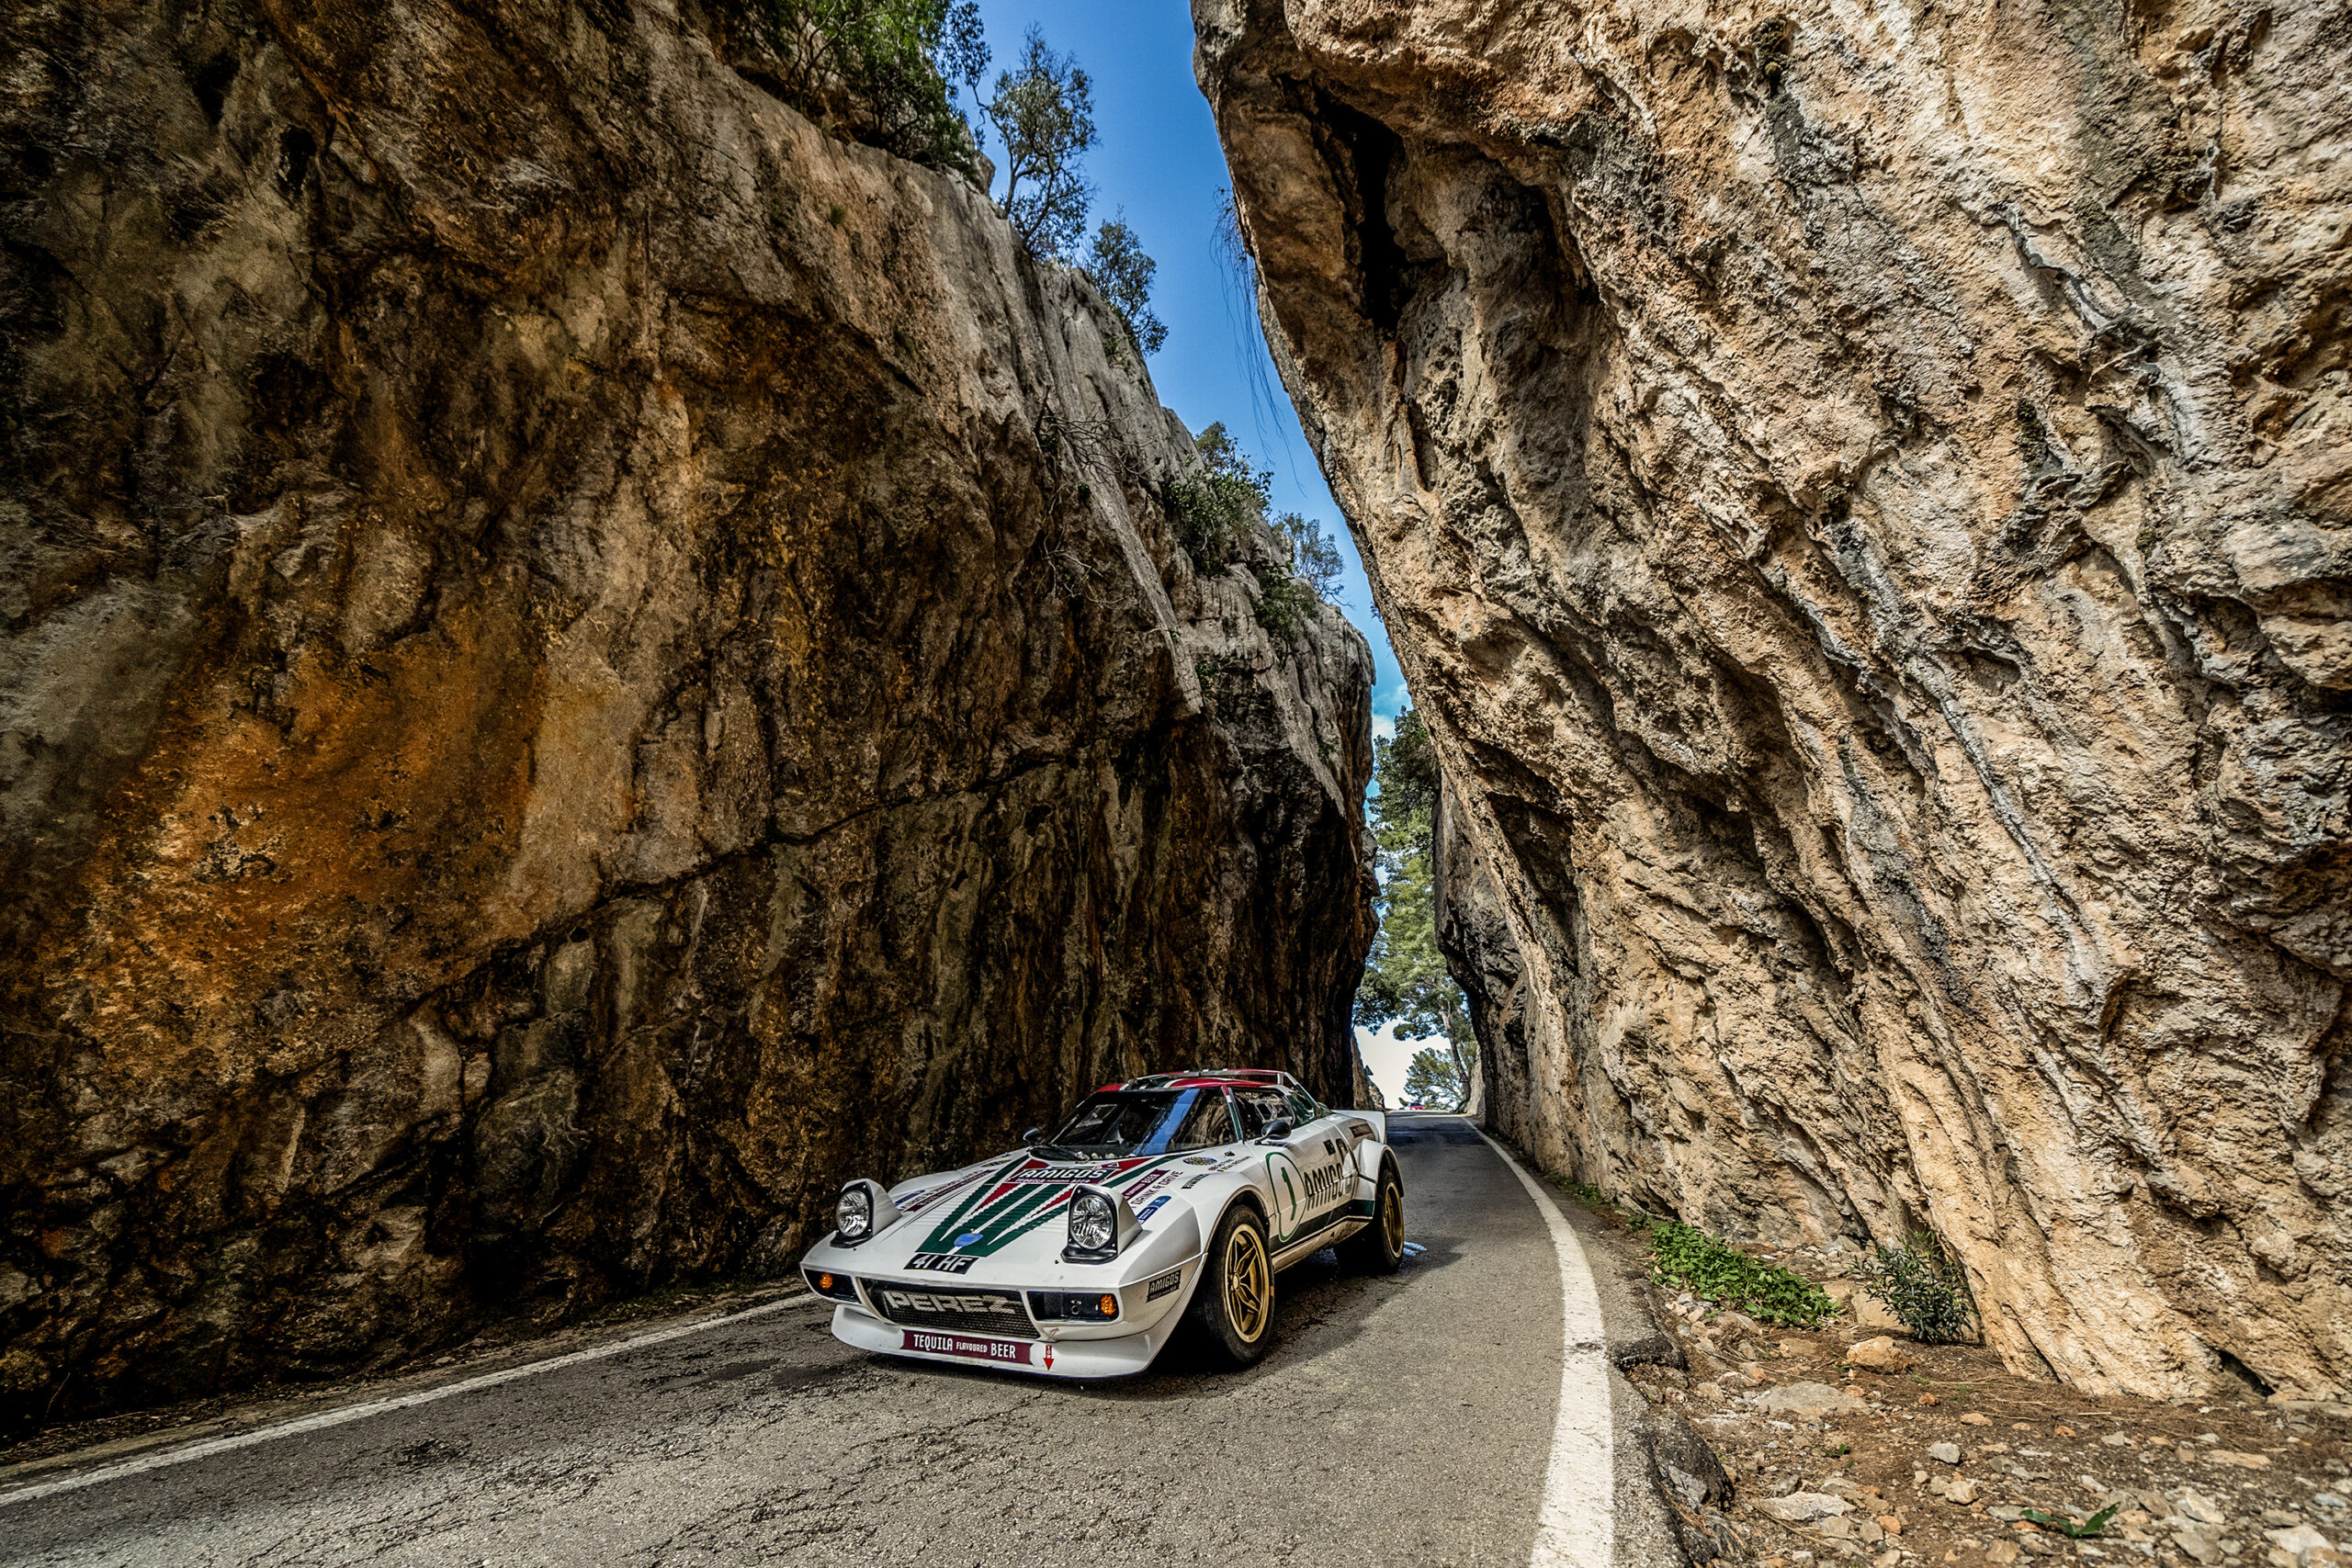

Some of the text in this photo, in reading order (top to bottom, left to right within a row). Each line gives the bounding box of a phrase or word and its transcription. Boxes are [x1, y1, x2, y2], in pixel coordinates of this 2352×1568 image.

[1022, 1168, 1108, 1179] AMIGOS
[1280, 1166, 1297, 1222] 1
[911, 1254, 974, 1271] 41 HF
[1149, 1271, 1181, 1294] AMIGOS
[883, 1290, 1017, 1314] PEREZ
[913, 1334, 1016, 1359] TEQUILA FLAVOURED BEER
